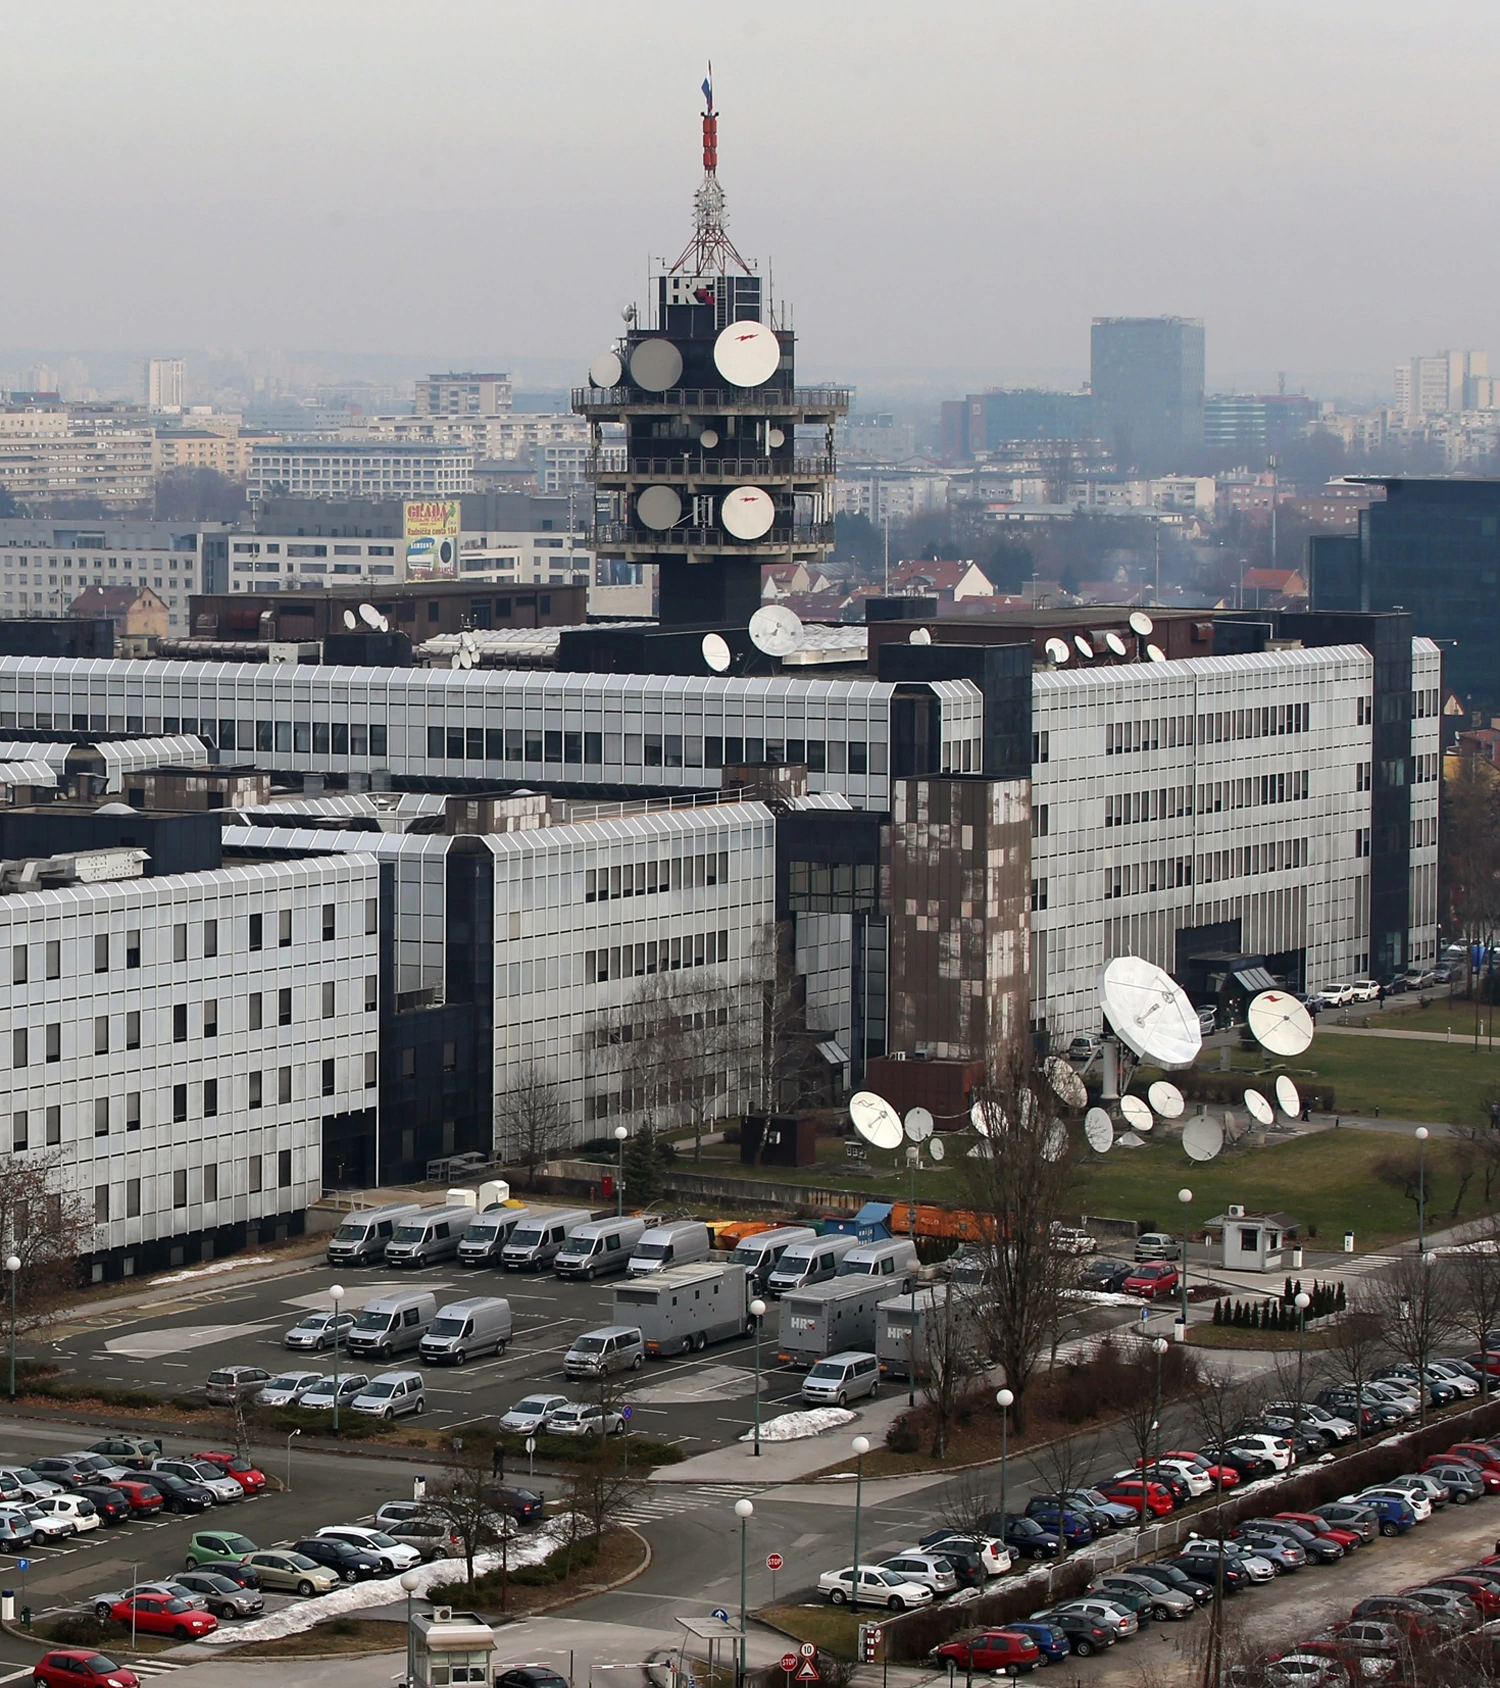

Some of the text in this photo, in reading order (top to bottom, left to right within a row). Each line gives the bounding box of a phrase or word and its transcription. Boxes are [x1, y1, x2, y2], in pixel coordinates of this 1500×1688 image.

[667, 278, 715, 305] HRT
[790, 1316, 816, 1331] HRT
[803, 1645, 812, 1655] 10
[782, 1658, 796, 1666] STOP
